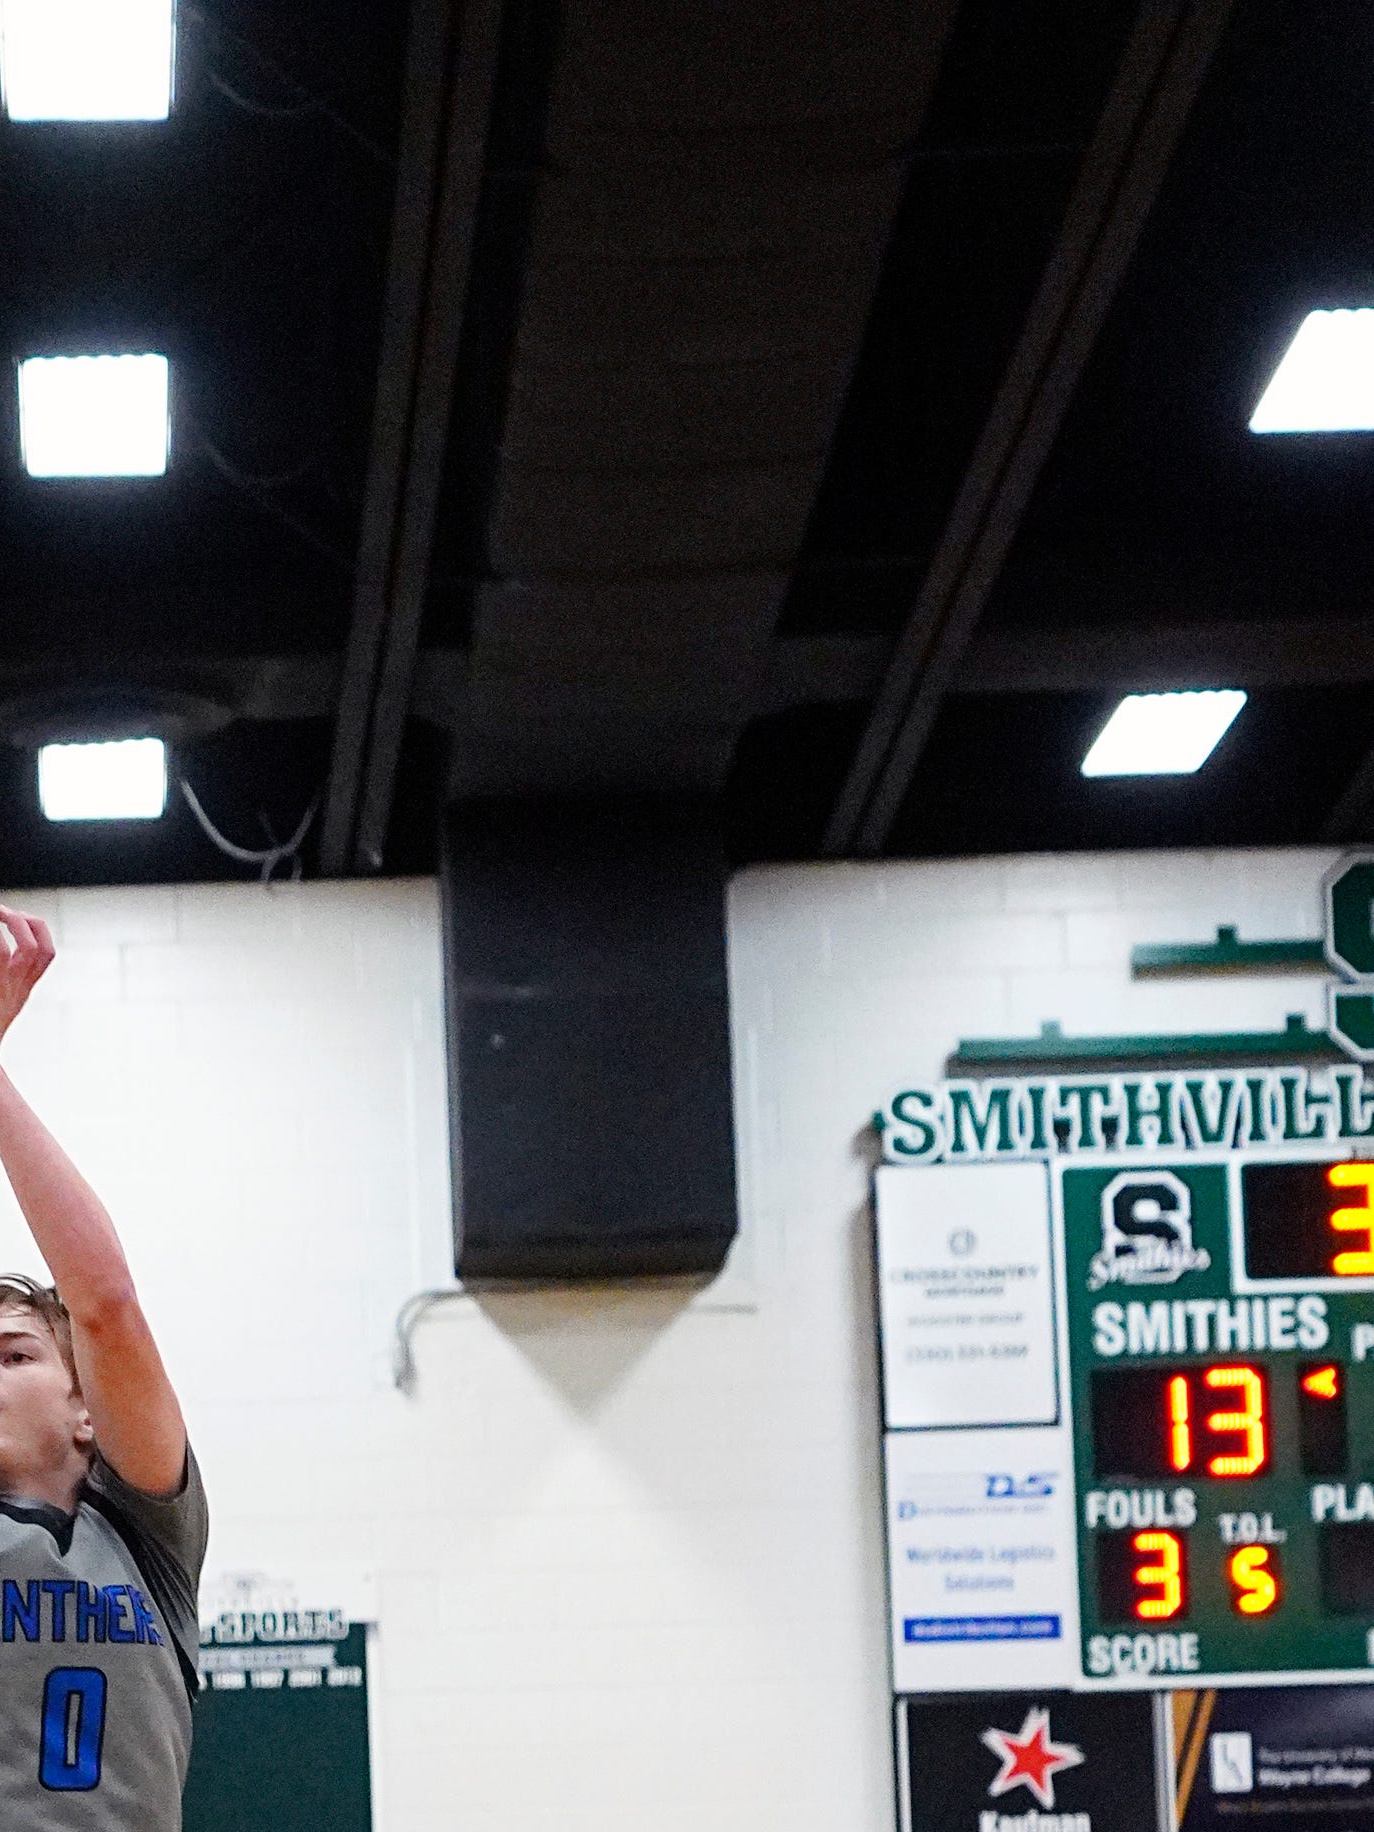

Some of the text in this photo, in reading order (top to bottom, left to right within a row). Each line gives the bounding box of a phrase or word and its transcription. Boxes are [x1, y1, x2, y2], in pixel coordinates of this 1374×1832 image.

[1093, 1297, 1329, 1356] SMITHIES
[1169, 1367, 1267, 1477] 13
[1086, 1485, 1197, 1528] FOULS
[1133, 1531, 1182, 1619] 3
[1088, 1632, 1200, 1674] SCORE
[38, 1666, 108, 1791] 0
